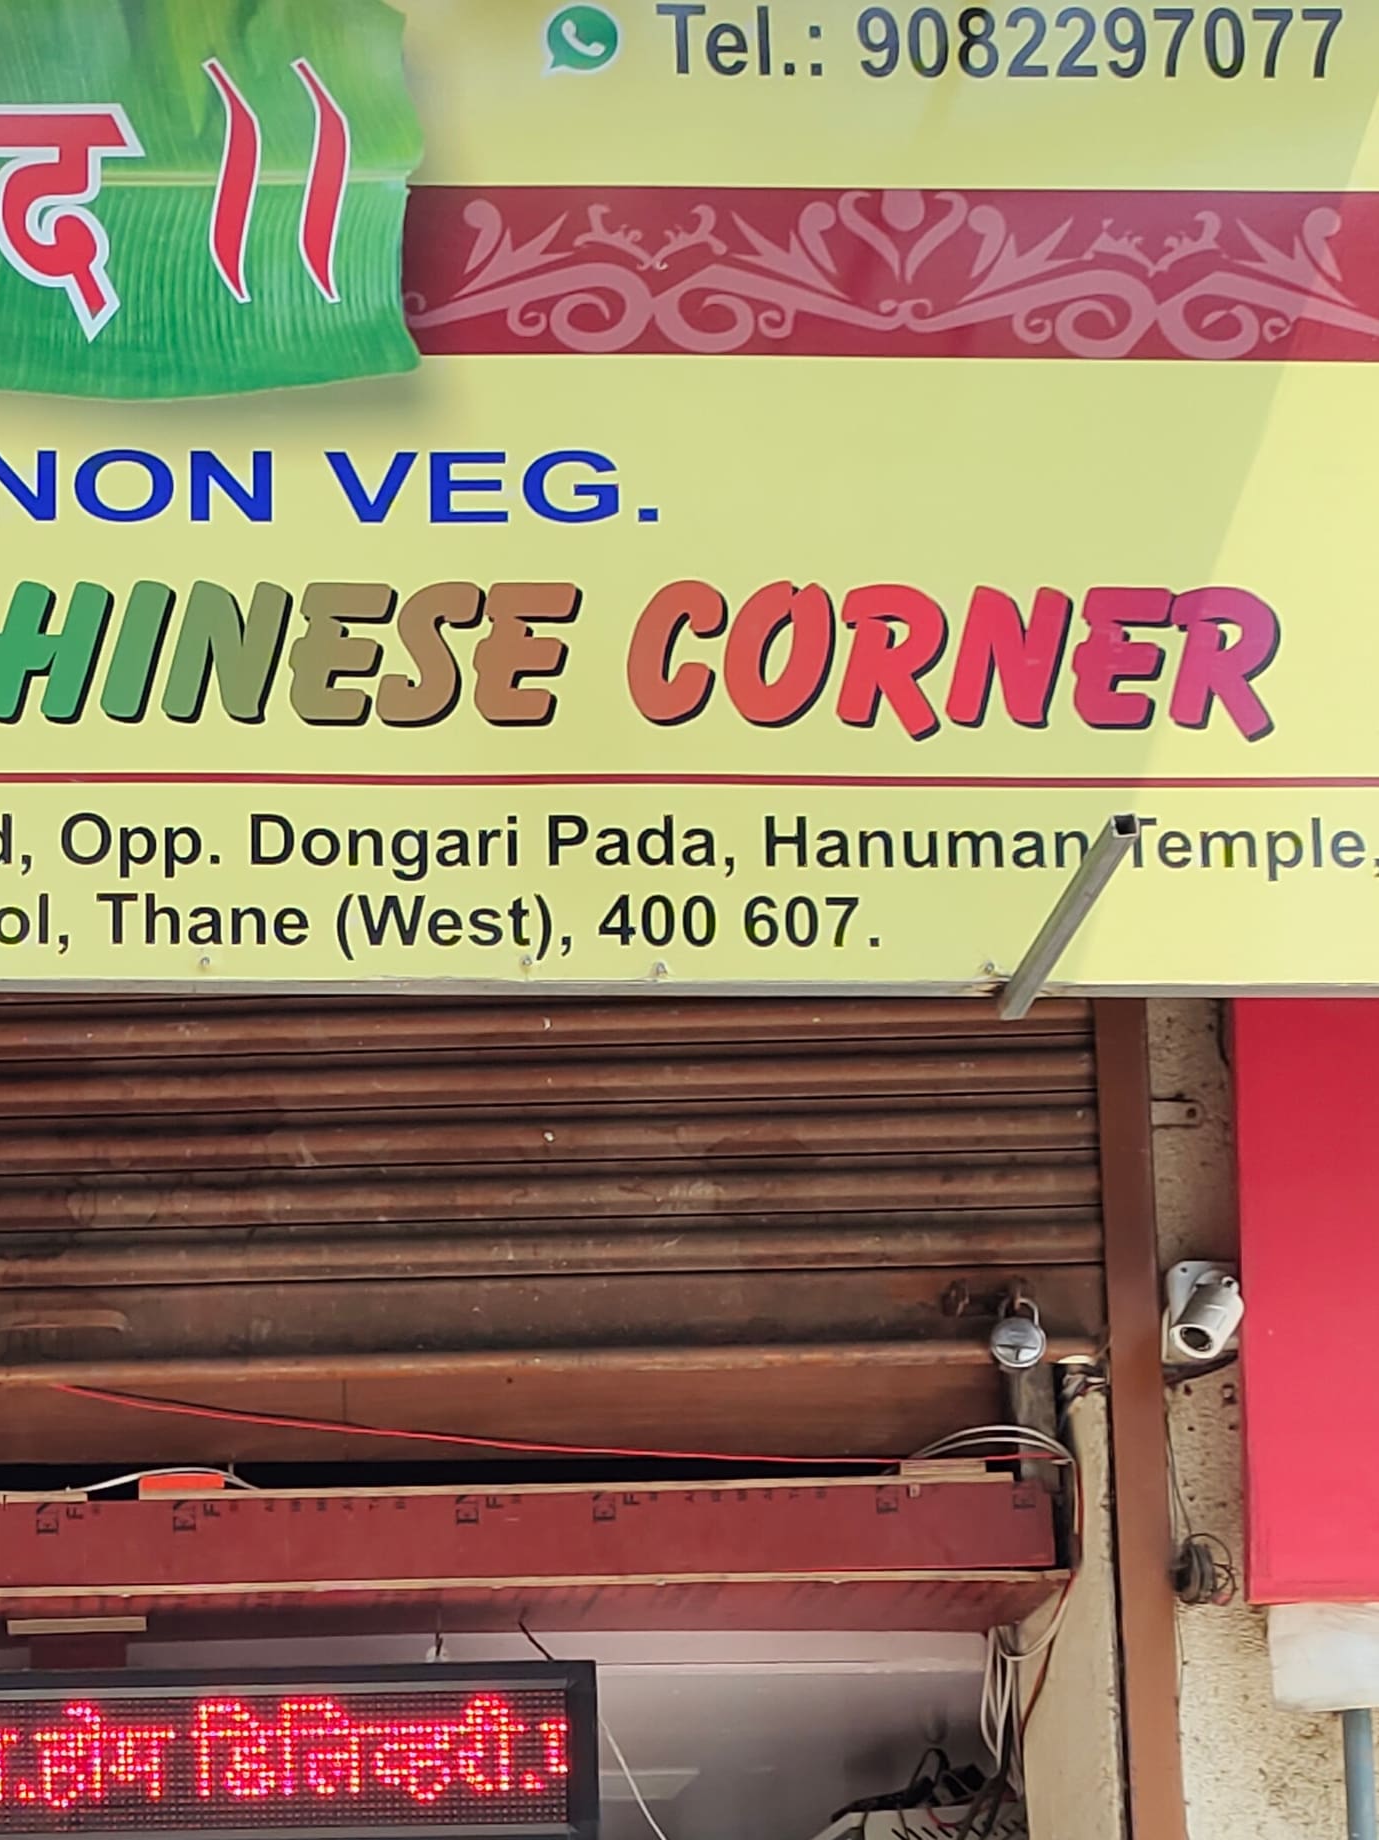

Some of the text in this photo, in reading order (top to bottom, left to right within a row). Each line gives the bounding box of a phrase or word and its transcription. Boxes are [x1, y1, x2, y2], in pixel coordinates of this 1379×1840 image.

[656, 4, 1344, 80] Tel.: 9082297077
[324, 448, 660, 525] VEG.
[626, 579, 1284, 746] CORNER
[60, 811, 221, 880] Opp.
[249, 812, 518, 883] Dongari
[548, 814, 736, 877] Pada,
[765, 816, 1088, 870] Hanuman
[96, 893, 310, 947] Thane
[336, 893, 572, 961] (West),
[599, 894, 717, 948] 400
[743, 896, 880, 950] 607.
